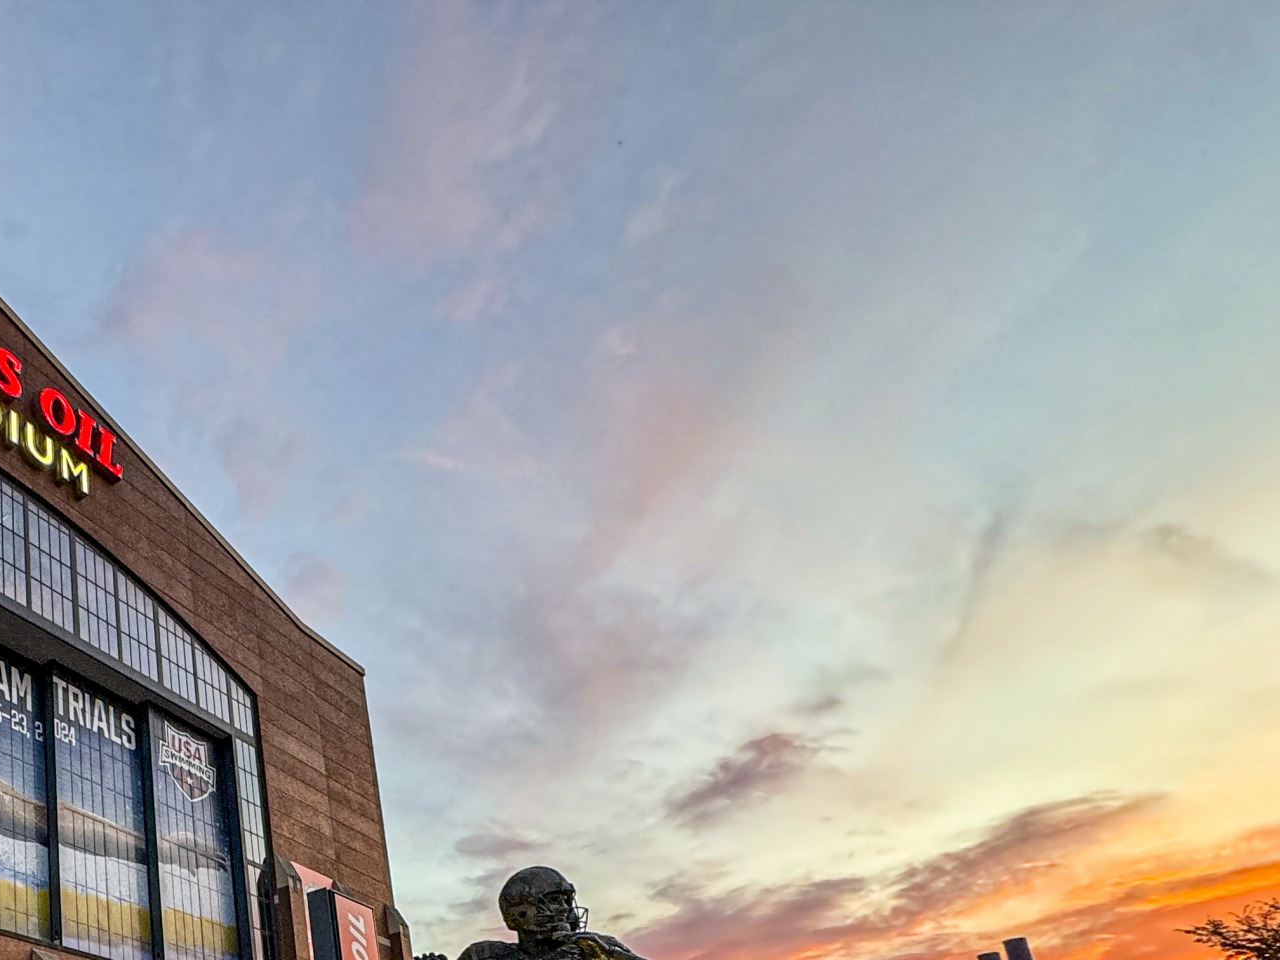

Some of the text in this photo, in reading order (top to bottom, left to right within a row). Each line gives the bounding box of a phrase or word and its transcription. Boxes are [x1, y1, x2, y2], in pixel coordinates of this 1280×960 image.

[38, 387, 123, 482] OIL
[52, 674, 137, 751] TRIALS
[163, 748, 212, 780] SWIMMING
[171, 734, 203, 765] USA
